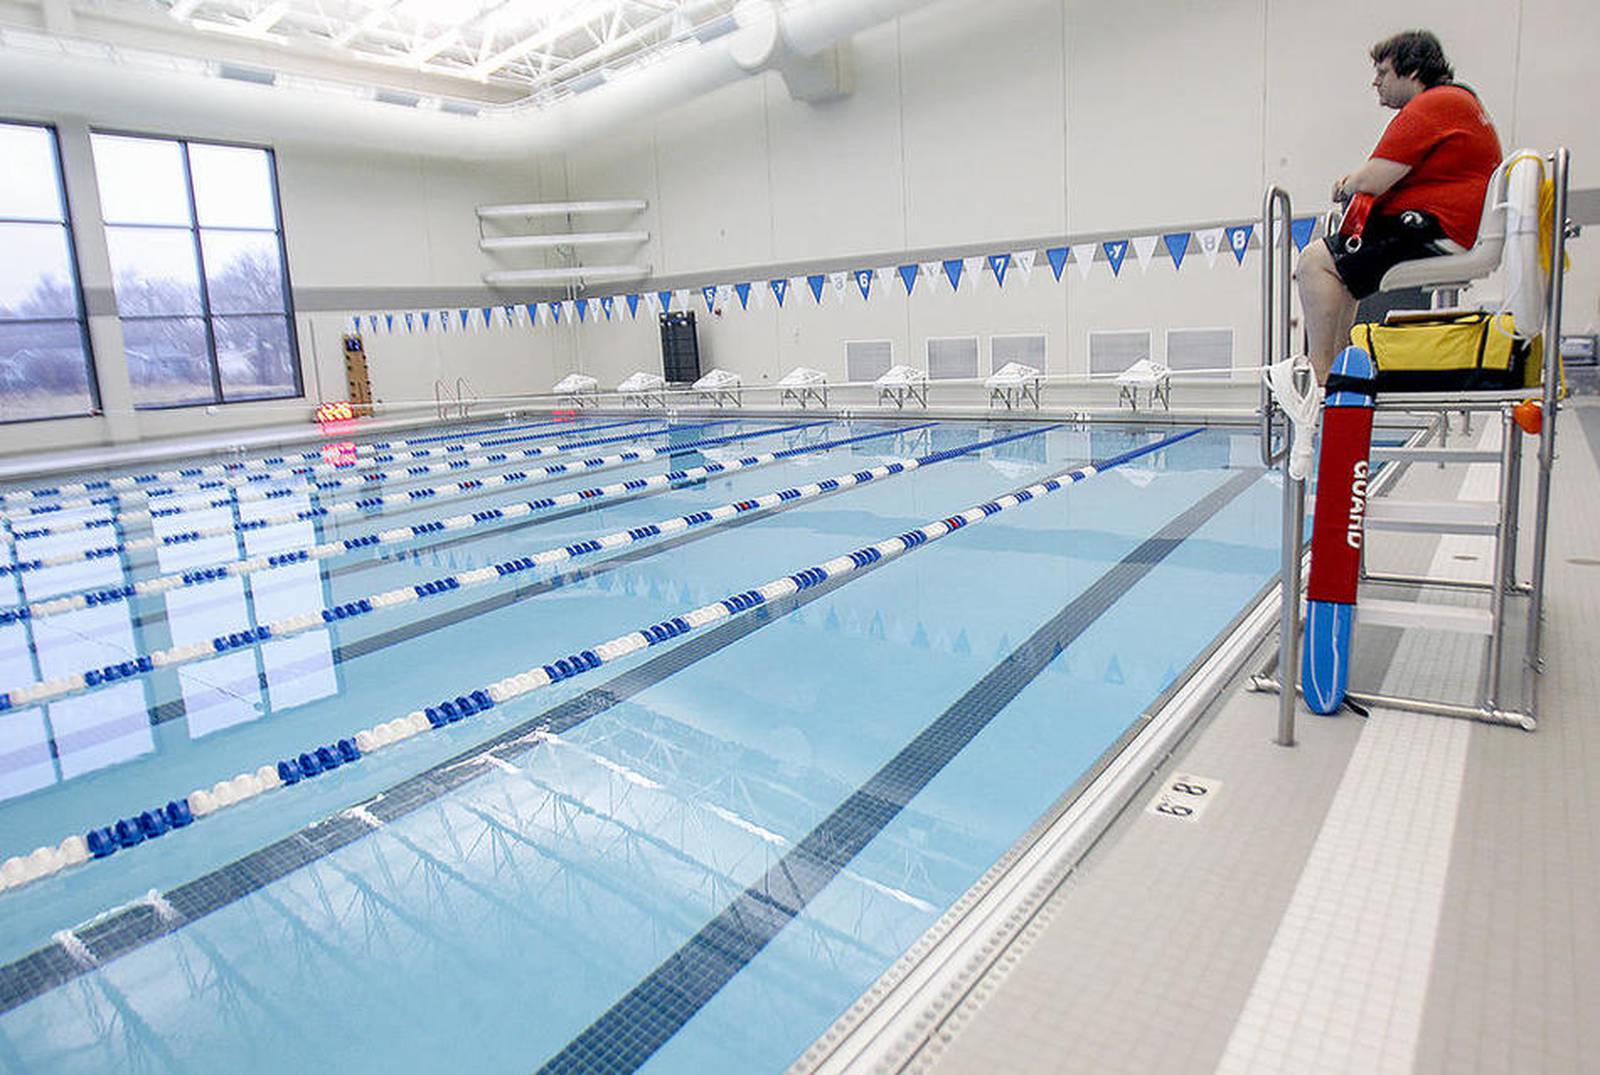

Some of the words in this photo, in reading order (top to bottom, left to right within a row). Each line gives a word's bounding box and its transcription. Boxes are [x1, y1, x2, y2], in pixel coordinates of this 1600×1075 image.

[1232, 230, 1246, 250] 8
[995, 257, 1004, 273] 7
[859, 272, 868, 288] 6
[1346, 460, 1369, 549] GUARD
